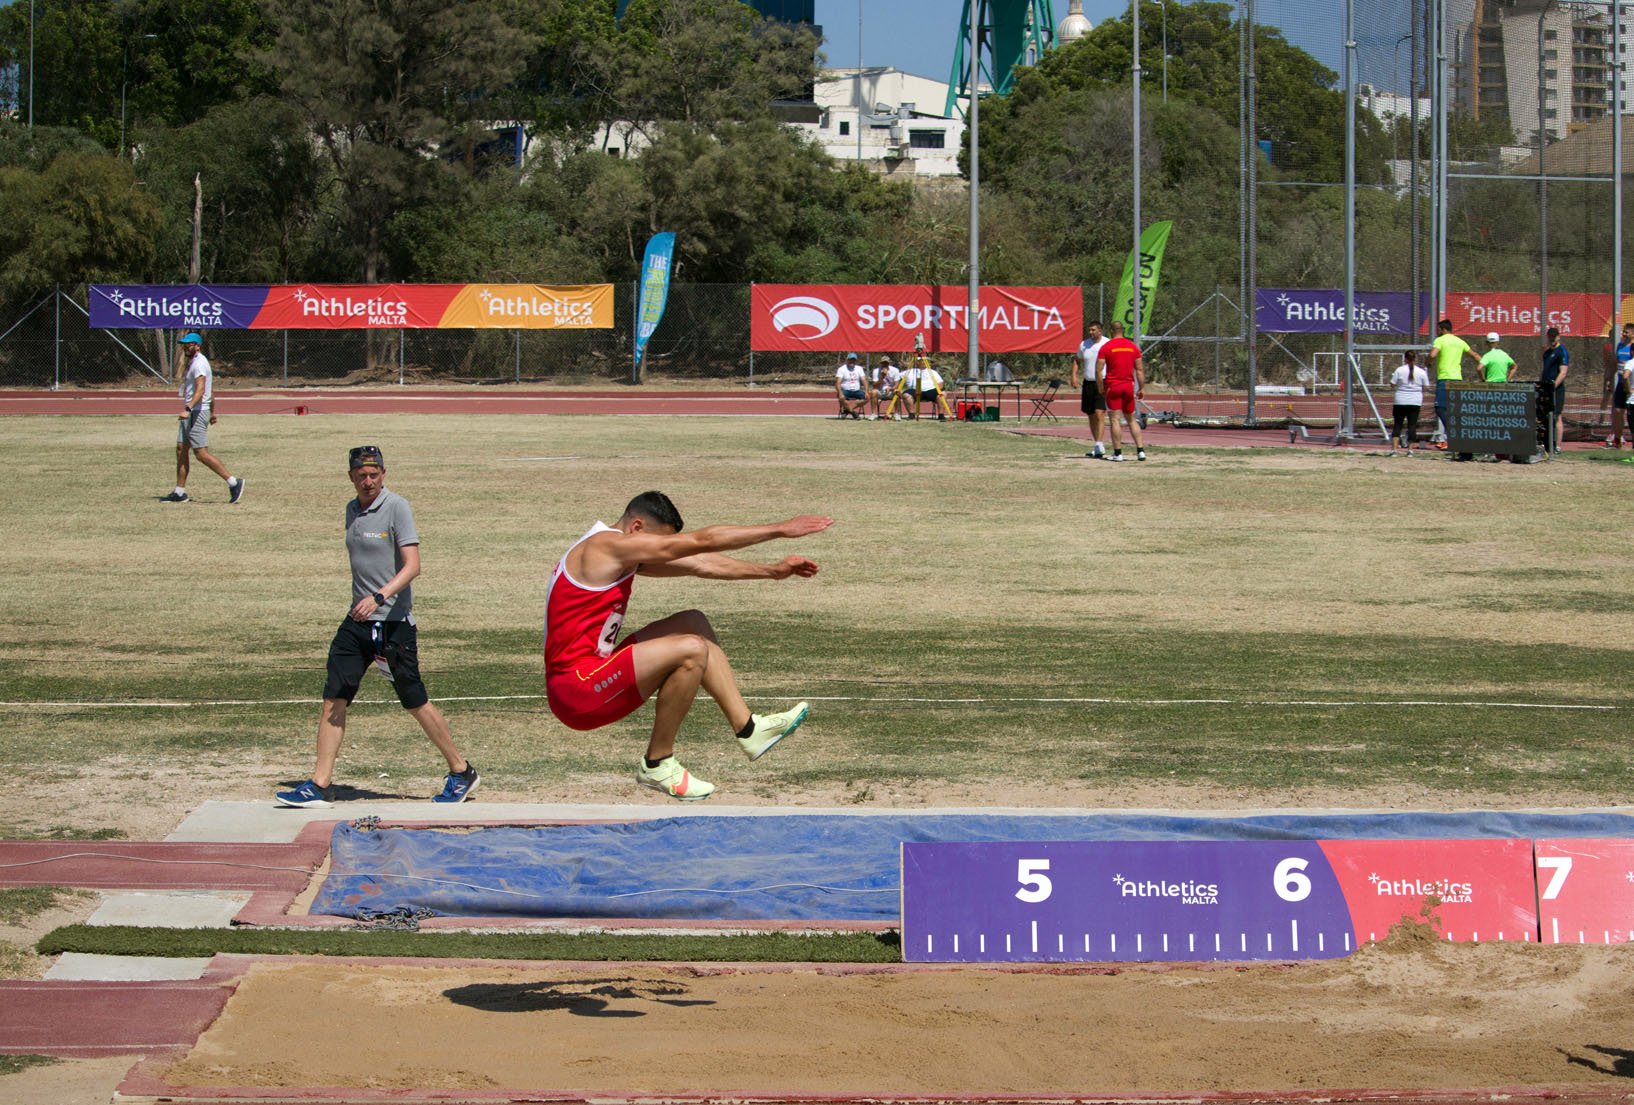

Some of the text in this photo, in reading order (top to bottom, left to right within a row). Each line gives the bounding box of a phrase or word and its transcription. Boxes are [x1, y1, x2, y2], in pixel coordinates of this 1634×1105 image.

[649, 254, 668, 269] THE
[120, 297, 223, 316] Athletics
[303, 297, 408, 316] Athletics
[488, 297, 593, 316] Athletics
[1286, 302, 1390, 322] Athletics
[1469, 305, 1571, 324] Athletcs
[184, 316, 223, 326] MALTA
[368, 316, 408, 326] MALTA
[554, 316, 593, 326] MALTA
[1449, 391, 1527, 402] 6 KONIARAKIS
[1449, 403, 1455, 413] 7
[1450, 416, 1456, 425] 8
[1460, 428, 1512, 440] FURTULA
[1015, 859, 1053, 903] 5
[1273, 857, 1312, 902] 6
[1538, 857, 1573, 899] 7
[1121, 880, 1219, 897] Athletics
[1377, 879, 1473, 896] Athletics
[1182, 896, 1219, 905] MALTA
